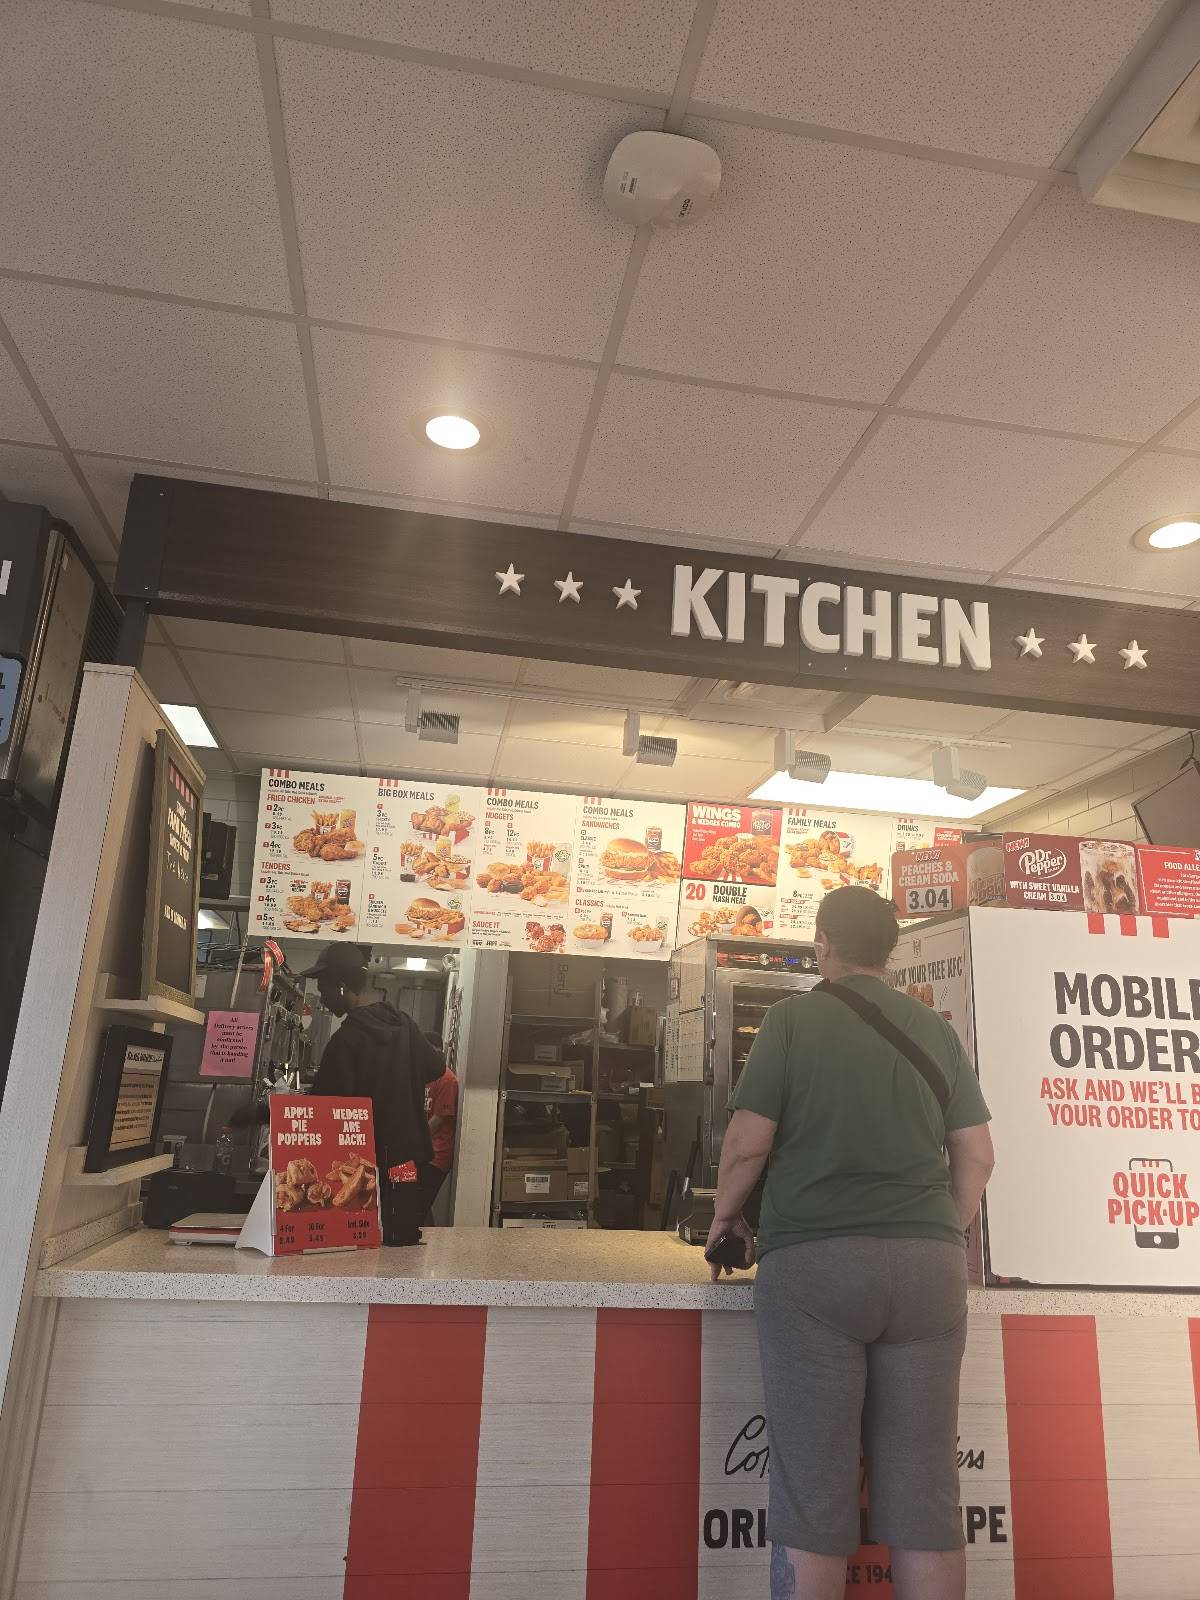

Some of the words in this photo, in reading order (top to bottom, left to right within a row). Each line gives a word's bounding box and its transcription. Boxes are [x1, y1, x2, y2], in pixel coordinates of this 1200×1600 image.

[671, 564, 991, 670] KITCHEN
[268, 778, 297, 789] COMBO
[299, 781, 325, 792] MEALS
[267, 793, 286, 802] FRIED
[287, 795, 316, 804] CHICKEN
[378, 788, 391, 797] BIG
[392, 790, 408, 799] BOX
[410, 791, 435, 801] MEALS
[487, 797, 513, 808] COMBO
[514, 799, 539, 810] MEALS
[485, 811, 514, 821] NUGGETS
[583, 806, 608, 816] COMBO
[610, 807, 634, 818] MEALS
[692, 805, 742, 822] WINGS
[581, 820, 620, 830] SANDWICHES
[721, 820, 741, 829] COMBO
[787, 817, 812, 828] FAMILY
[813, 819, 837, 829] MEALS
[1035, 849, 1051, 861] Dr
[261, 862, 290, 870] TENDERS
[901, 862, 943, 875] PEACHES
[945, 860, 953, 872] &
[1025, 852, 1063, 876] Pepper
[1164, 862, 1182, 870] FOOD
[899, 875, 931, 888] CREAM
[933, 872, 960, 884] SODA
[686, 883, 706, 901] 20
[713, 885, 748, 898] DOUBLE
[1010, 881, 1028, 890] WITH
[1029, 882, 1051, 891] SWEET
[1052, 884, 1080, 893] VANILLA
[713, 895, 730, 904] MASH
[730, 896, 747, 905] MEAL
[909, 889, 950, 910] 3.04
[1024, 891, 1047, 901] CREAM
[575, 899, 604, 908] CLASSICS
[472, 920, 493, 929] SAUCE
[493, 921, 500, 929] IT
[908, 964, 926, 984] YOUR
[927, 960, 945, 981] FREE
[947, 956, 962, 978] KFC
[1040, 1077, 1079, 1101] ASK
[1084, 1078, 1125, 1102] AND
[1130, 1080, 1187, 1104] WE'LL
[284, 1106, 314, 1119] APPLE
[332, 1108, 369, 1121] WEDGES
[1048, 1103, 1102, 1128] YOUR
[1106, 1106, 1173, 1131] ORDER
[1177, 1109, 1200, 1132] TO
[292, 1120, 308, 1132] PIE
[343, 1121, 361, 1133] ARE
[278, 1133, 322, 1146] POPPERS
[339, 1133, 366, 1146] BACK!
[1112, 1171, 1188, 1199] QUICK
